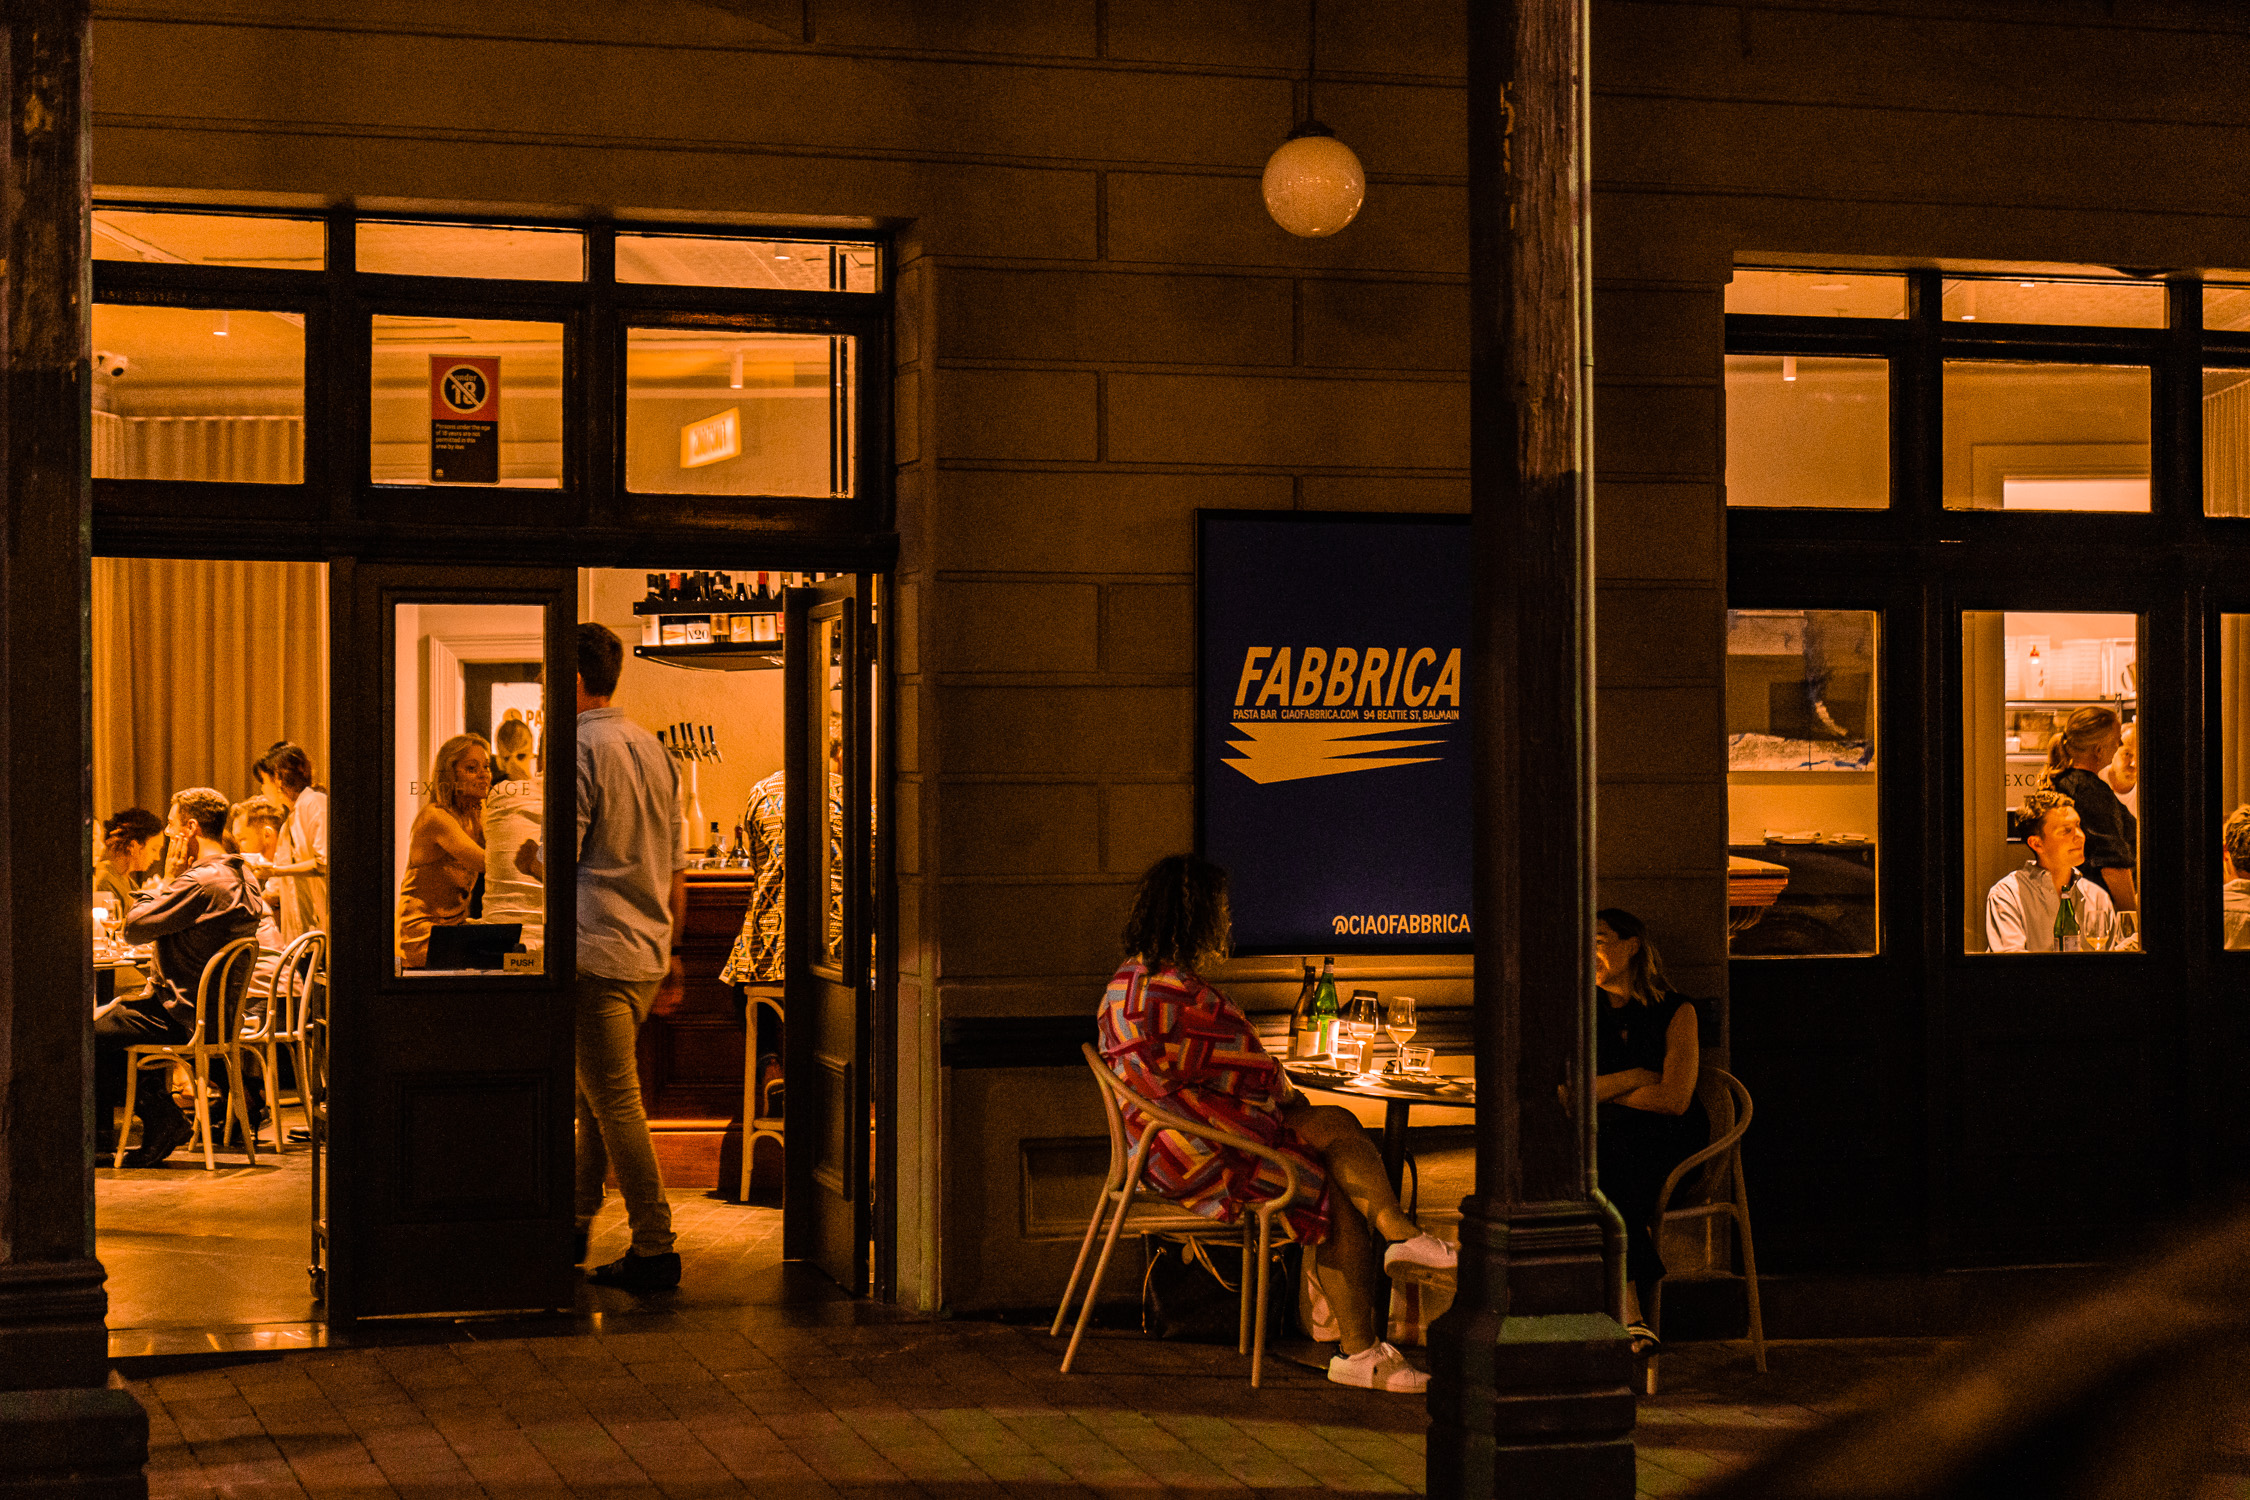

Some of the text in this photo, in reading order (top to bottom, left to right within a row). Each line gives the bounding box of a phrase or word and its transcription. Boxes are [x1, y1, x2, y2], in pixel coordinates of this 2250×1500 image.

[451, 381, 477, 405] 18
[1234, 646, 1462, 707] FABBRICA
[1233, 709, 1460, 722] PASTA BAR CIAOFABBRICA.COM 94 BEATTIE ST, BALMAIN
[409, 781, 530, 796] EXCHNGE
[1332, 913, 1471, 935] @CIAOFABBRICA
[510, 959, 534, 967] PUSH
